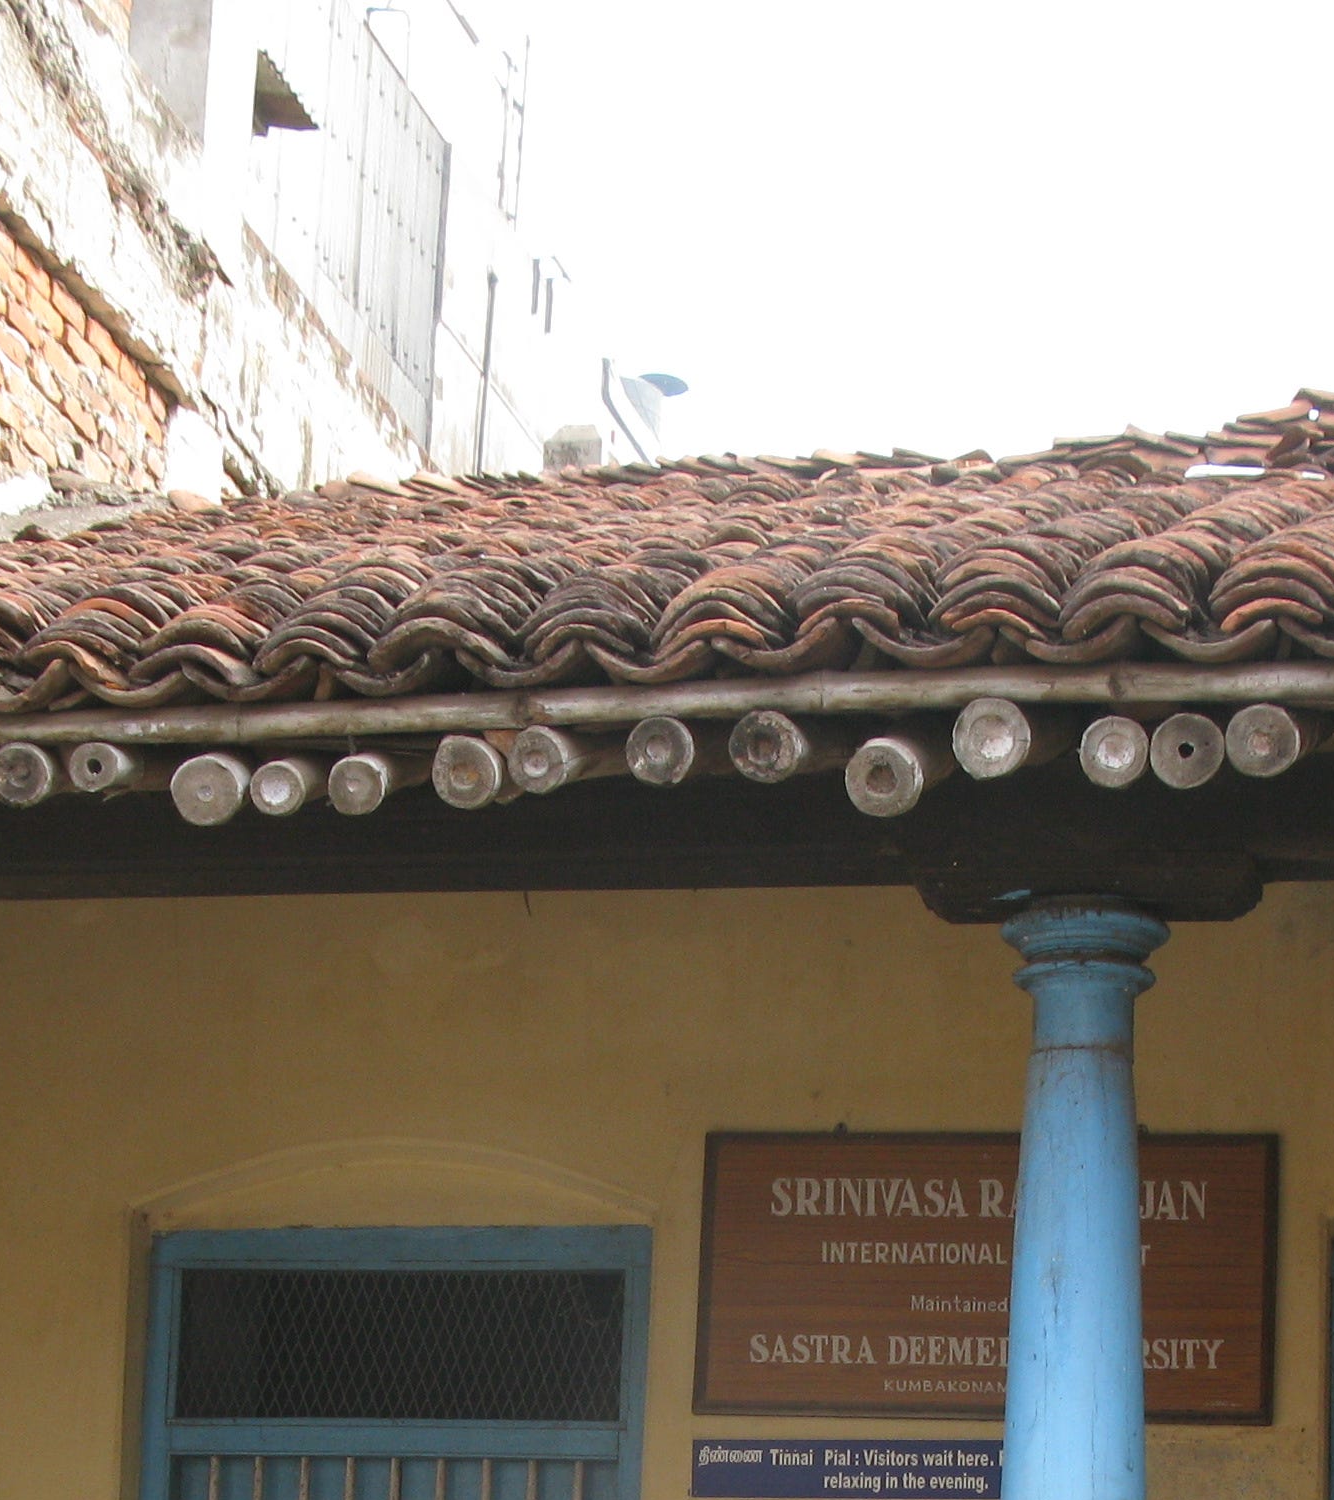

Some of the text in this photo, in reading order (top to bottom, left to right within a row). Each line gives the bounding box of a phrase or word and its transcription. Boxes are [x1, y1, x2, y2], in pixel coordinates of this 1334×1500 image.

[771, 1177, 969, 1217] SRINIVASA
[822, 1242, 1007, 1265] INTERNATIONAL
[911, 1295, 1008, 1312] Maintained
[749, 1334, 878, 1365] SASTRA
[824, 1449, 851, 1466] Pial
[864, 1450, 918, 1467] Visitors
[922, 1451, 954, 1467] wait
[958, 1450, 994, 1467] here.
[824, 1472, 989, 1493] relaxing in the evening.
